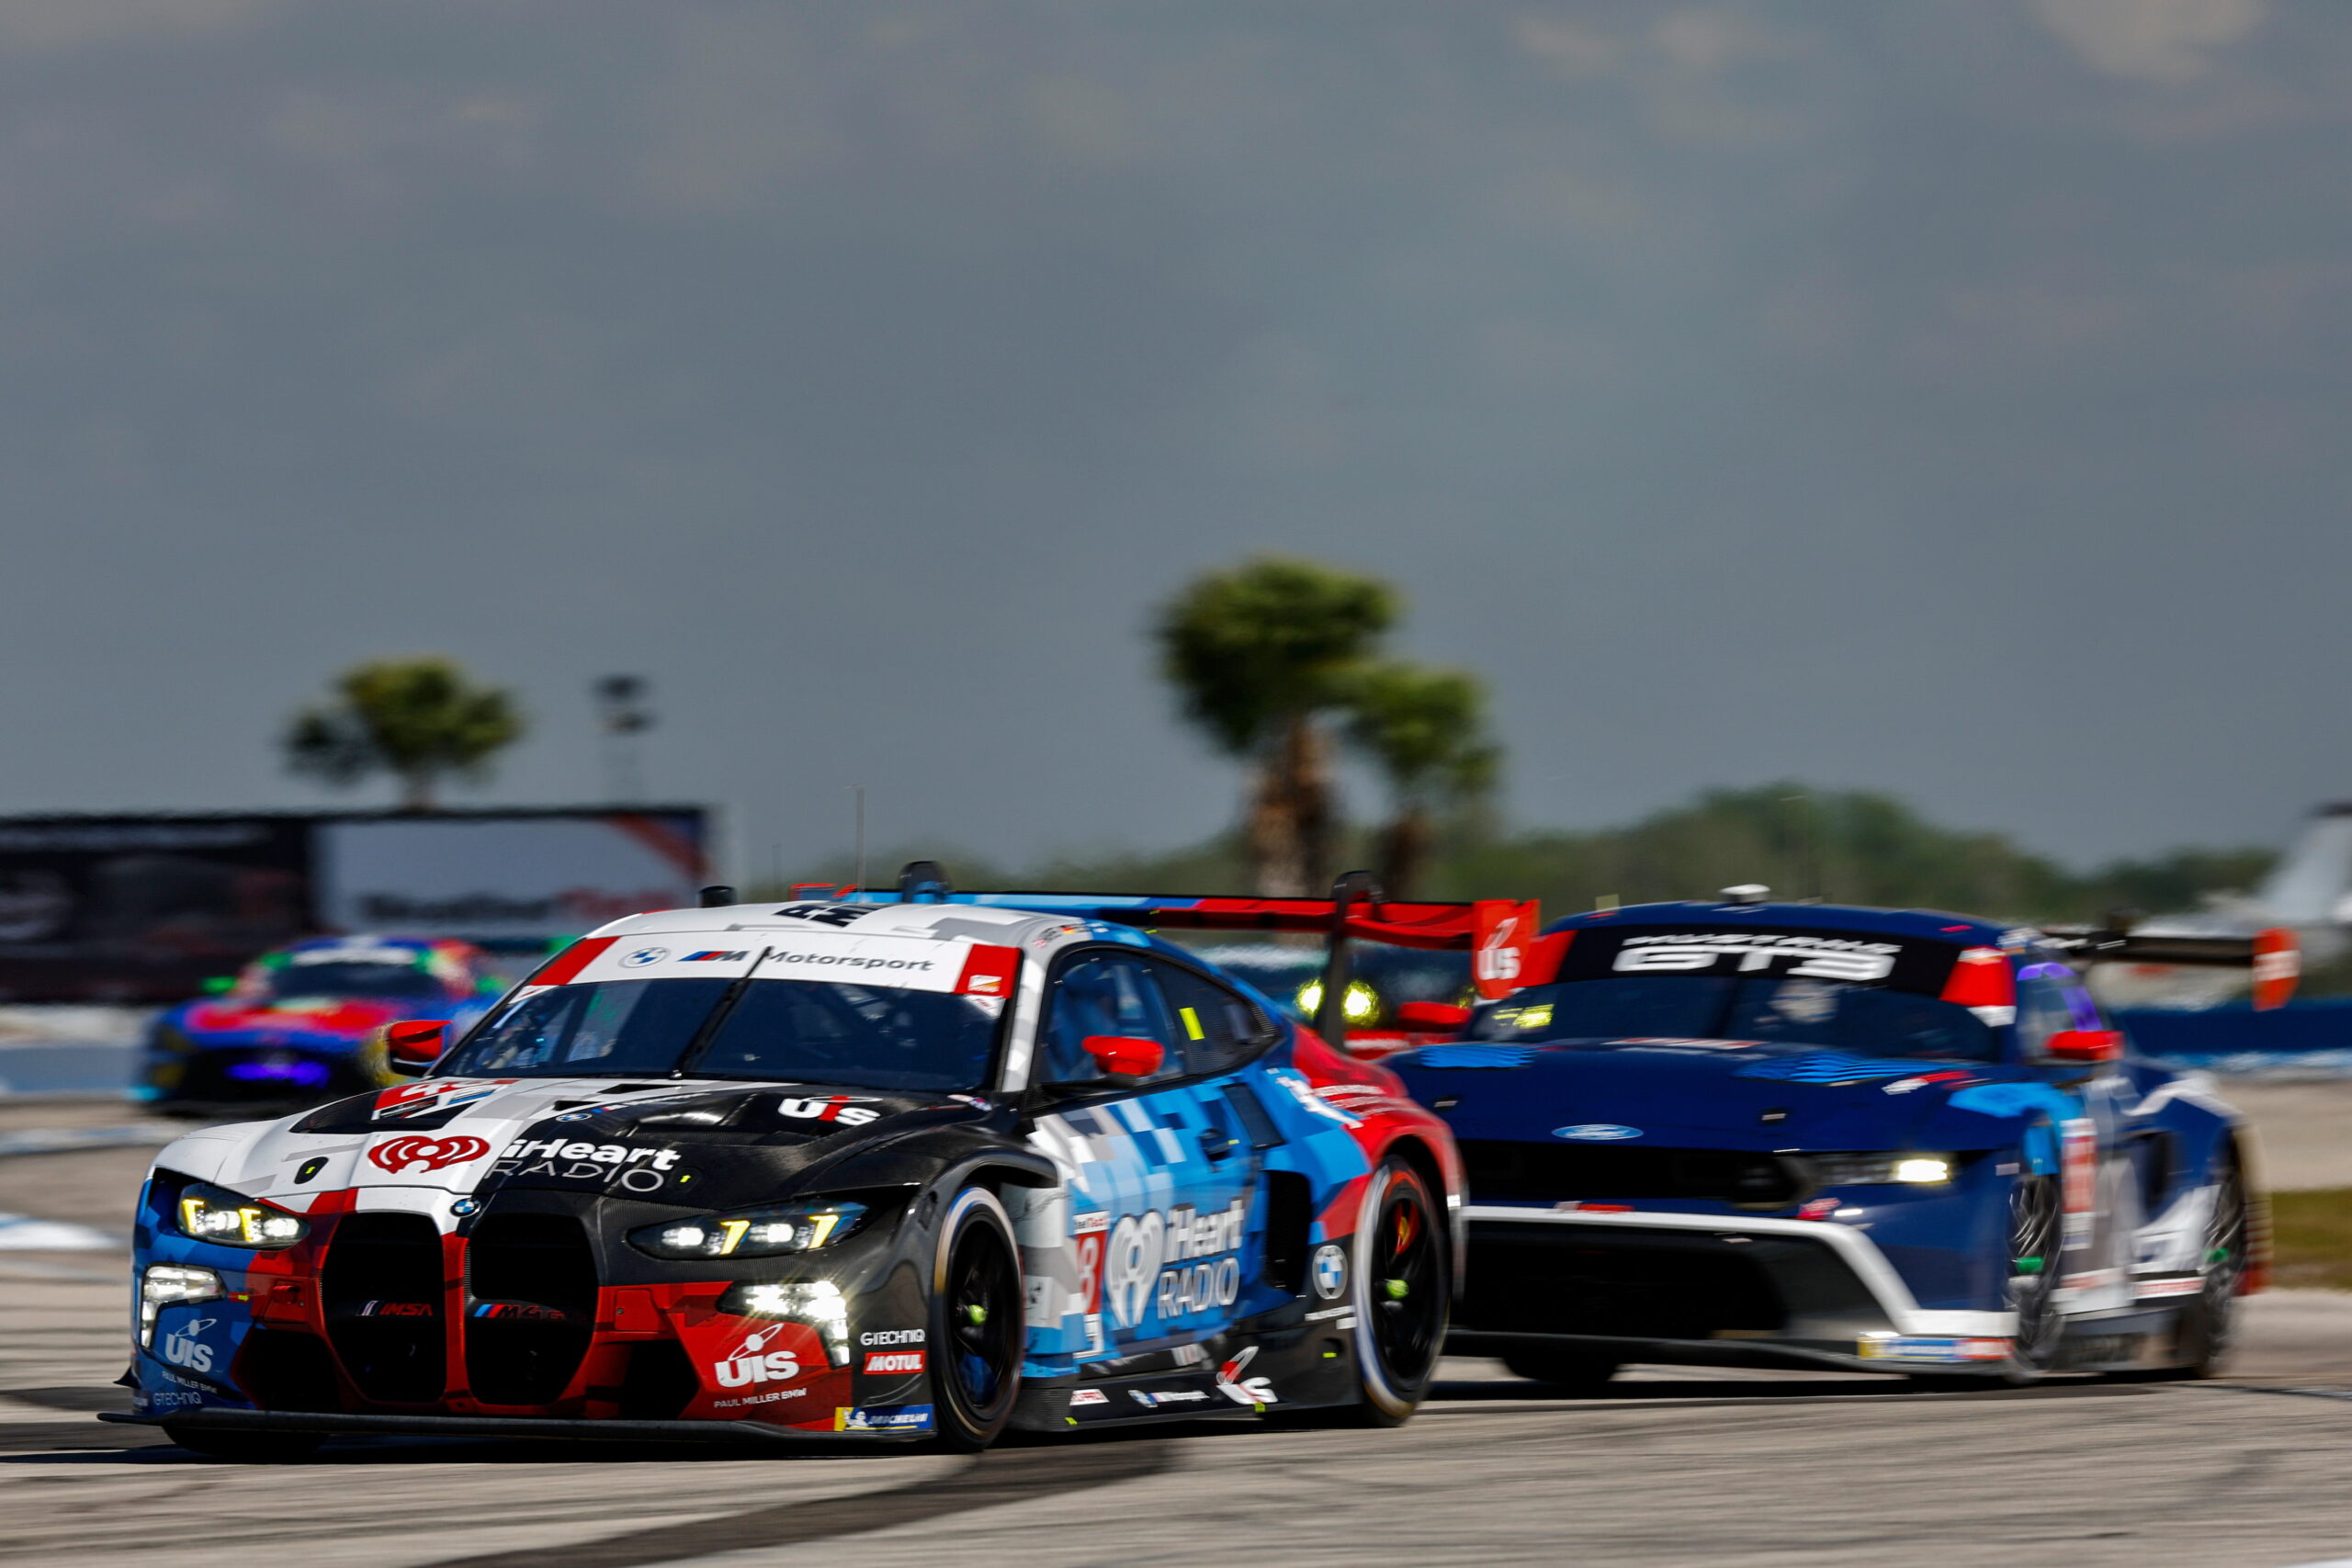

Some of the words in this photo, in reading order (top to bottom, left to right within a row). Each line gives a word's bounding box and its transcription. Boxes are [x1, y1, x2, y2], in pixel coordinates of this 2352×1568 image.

[767, 951, 934, 971] Motorsport
[1612, 944, 1896, 981] GT3
[501, 1138, 681, 1170] iHeart
[484, 1160, 664, 1192] RADIO
[1163, 1198, 1244, 1263] iHeart
[1159, 1258, 1239, 1319] RADIO
[379, 1302, 435, 1316] IMSA
[165, 1333, 214, 1372] UIS
[866, 1354, 922, 1371] MOTUL
[715, 1351, 800, 1388] UIS
[714, 1398, 741, 1409] PAUL
[742, 1392, 780, 1406] MILLER
[781, 1388, 807, 1400] BMW
